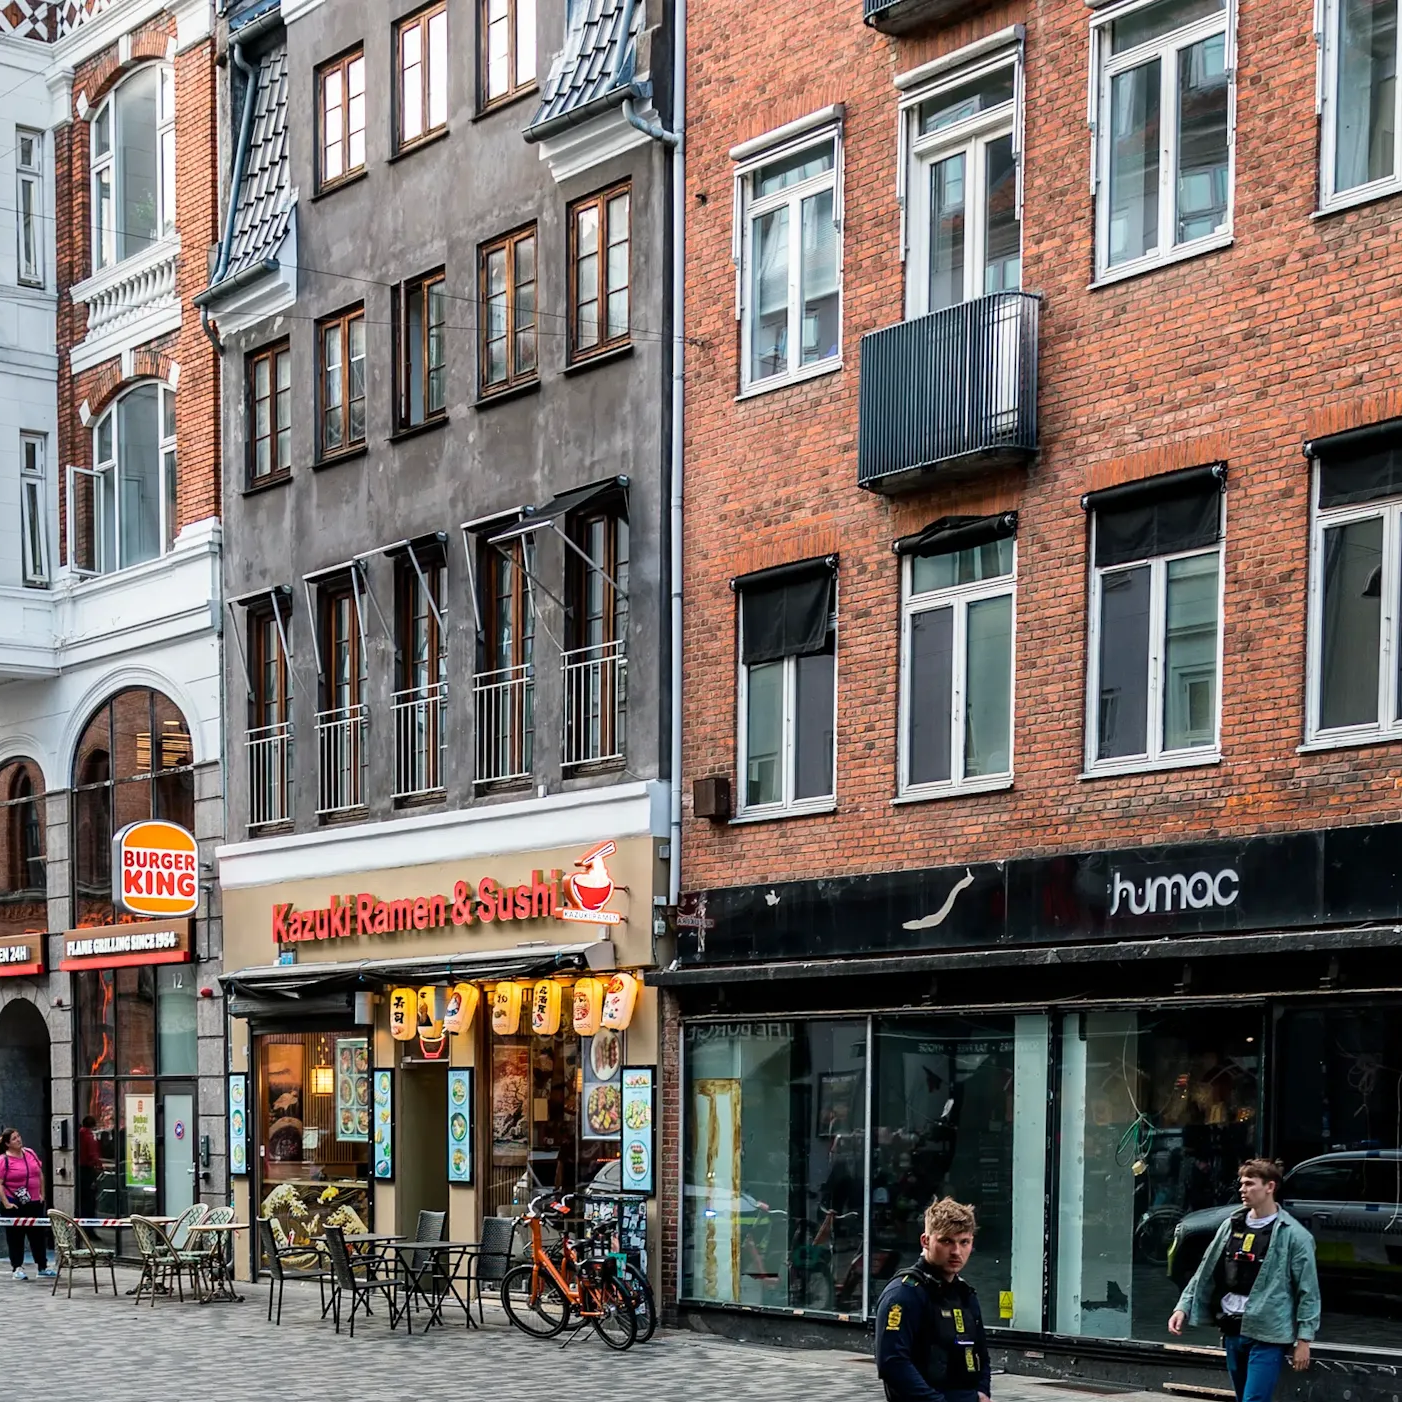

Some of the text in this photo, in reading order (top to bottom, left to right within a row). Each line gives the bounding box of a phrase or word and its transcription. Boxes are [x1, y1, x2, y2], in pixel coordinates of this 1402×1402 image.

[124, 850, 196, 872] BURGER
[123, 869, 196, 897] KING
[1109, 868, 1240, 917] humac
[272, 868, 559, 944] Kazuki Ramen & Sushi
[563, 910, 620, 924] KAZUKI RAMEN
[10, 946, 27, 962] 24H
[66, 931, 176, 956] FLAME GRILLING SINCE 1954
[172, 972, 183, 989] 12
